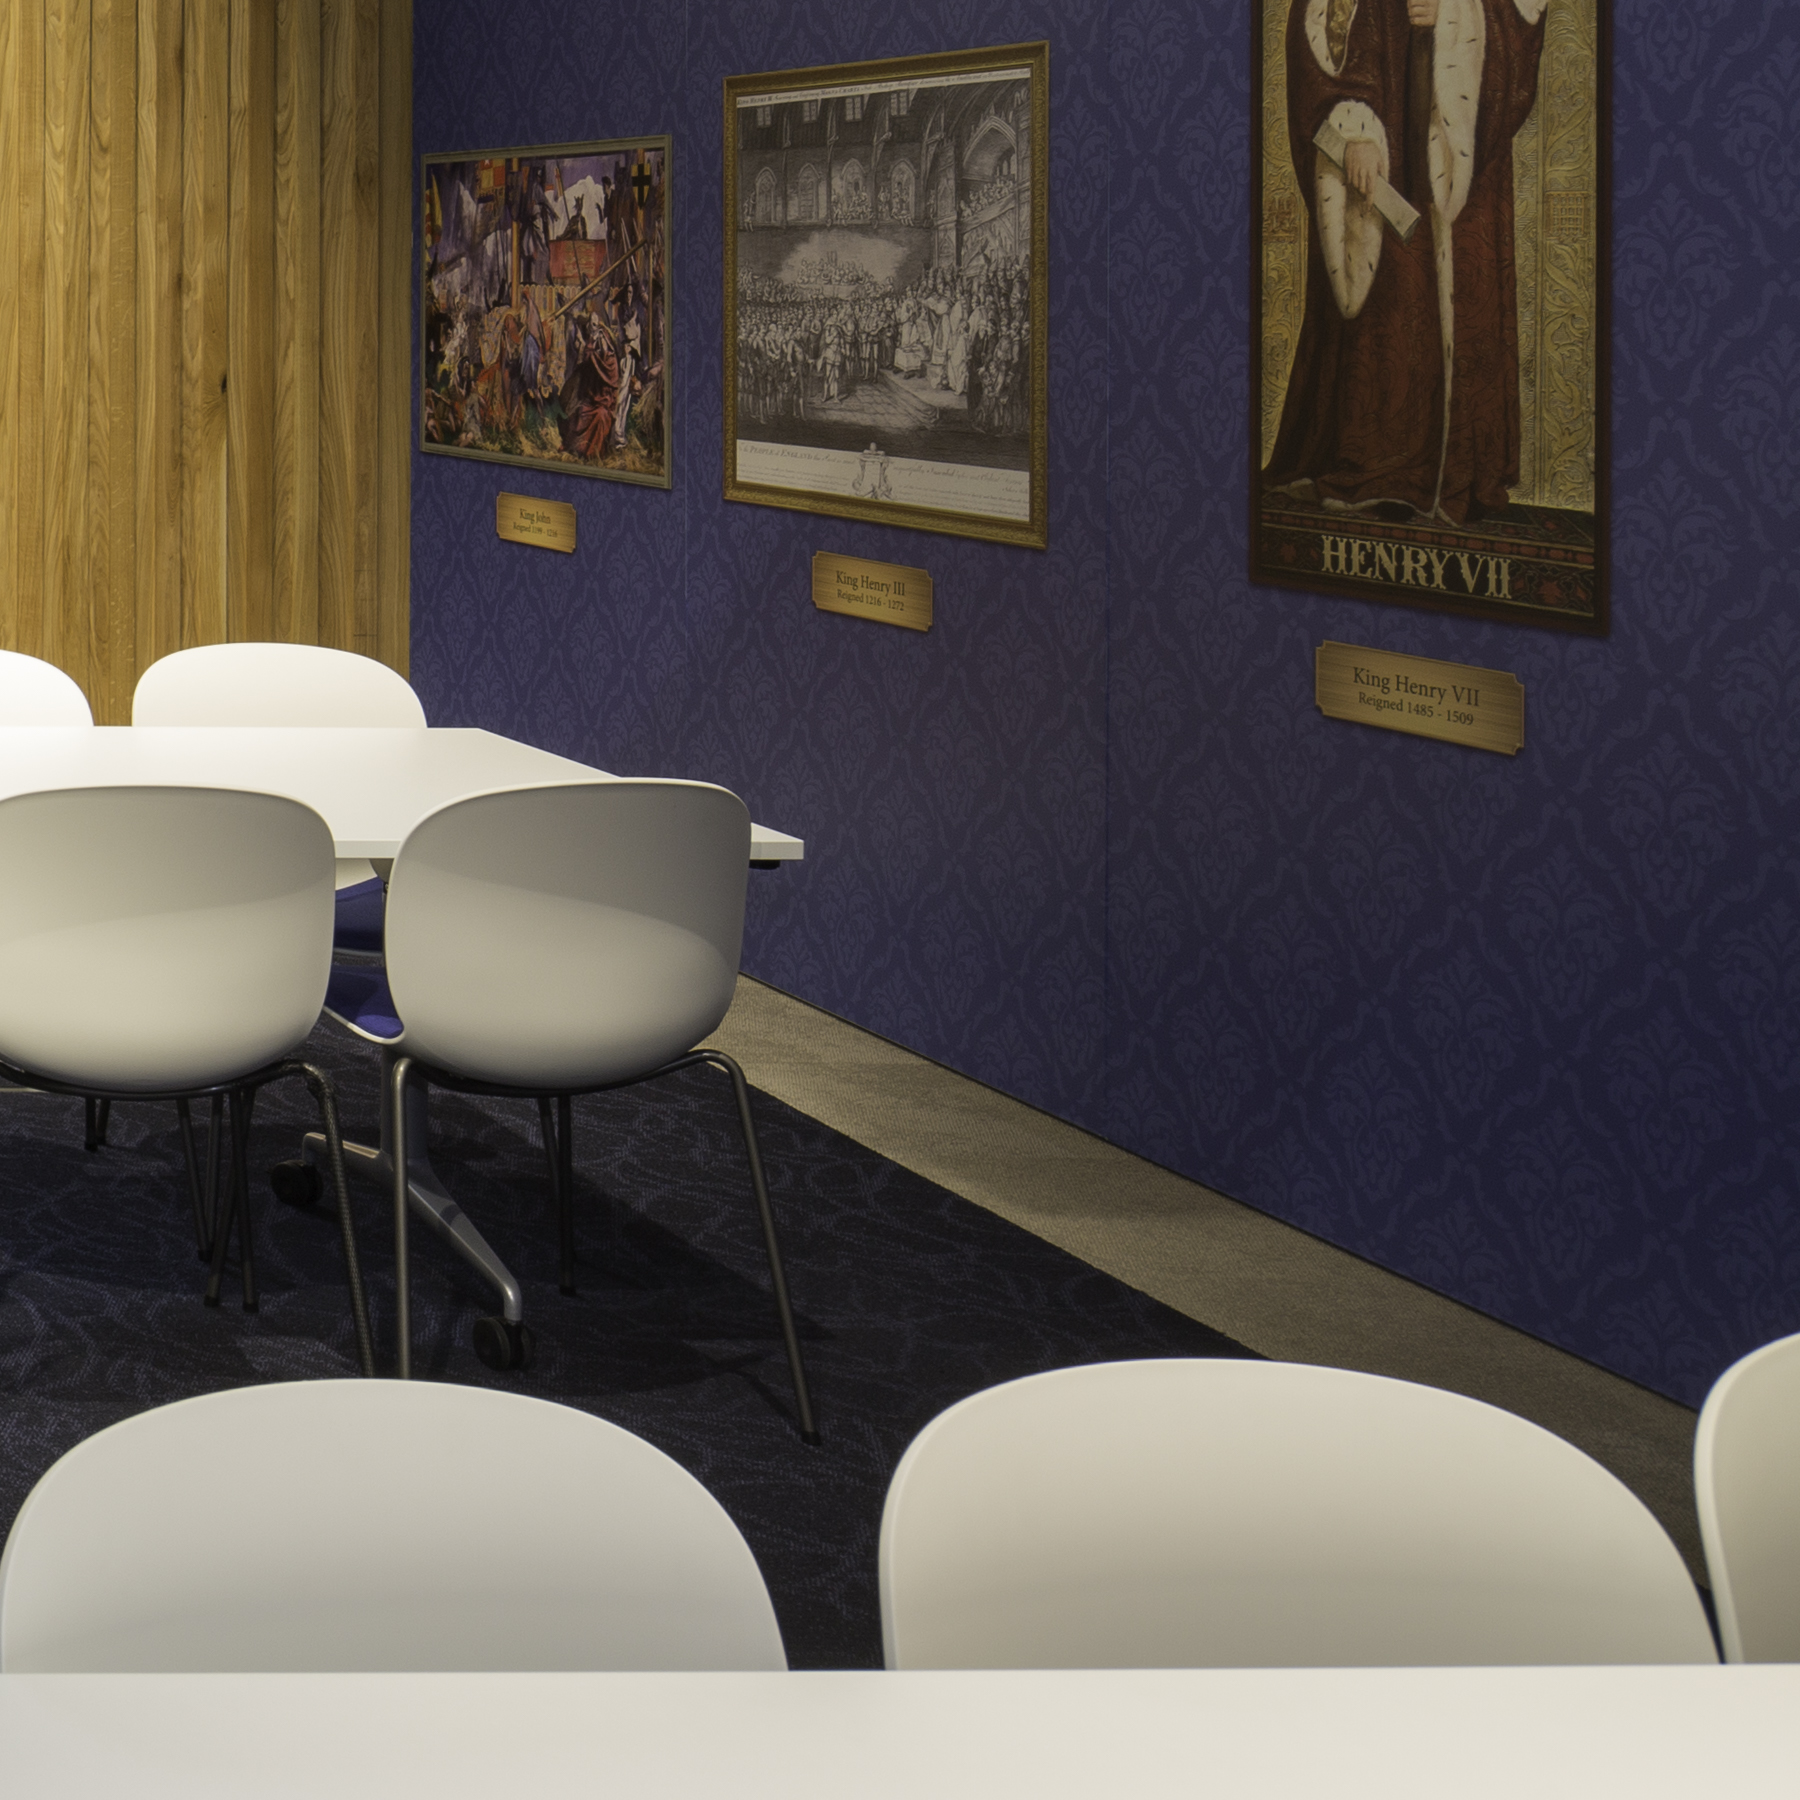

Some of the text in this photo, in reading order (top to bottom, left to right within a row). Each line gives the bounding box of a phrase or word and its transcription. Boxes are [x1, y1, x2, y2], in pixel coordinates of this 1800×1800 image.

[520, 508, 551, 524] King John
[1321, 534, 1512, 600] HENRY VII
[836, 570, 905, 597] King Henry III
[837, 589, 864, 603] Reigned
[865, 595, 882, 606] 1216
[888, 600, 905, 611] 1272
[1352, 666, 1480, 707] King Henry VII
[1358, 691, 1404, 714] Reigned
[1407, 701, 1434, 718] 1485
[1446, 709, 1474, 726] 1509
